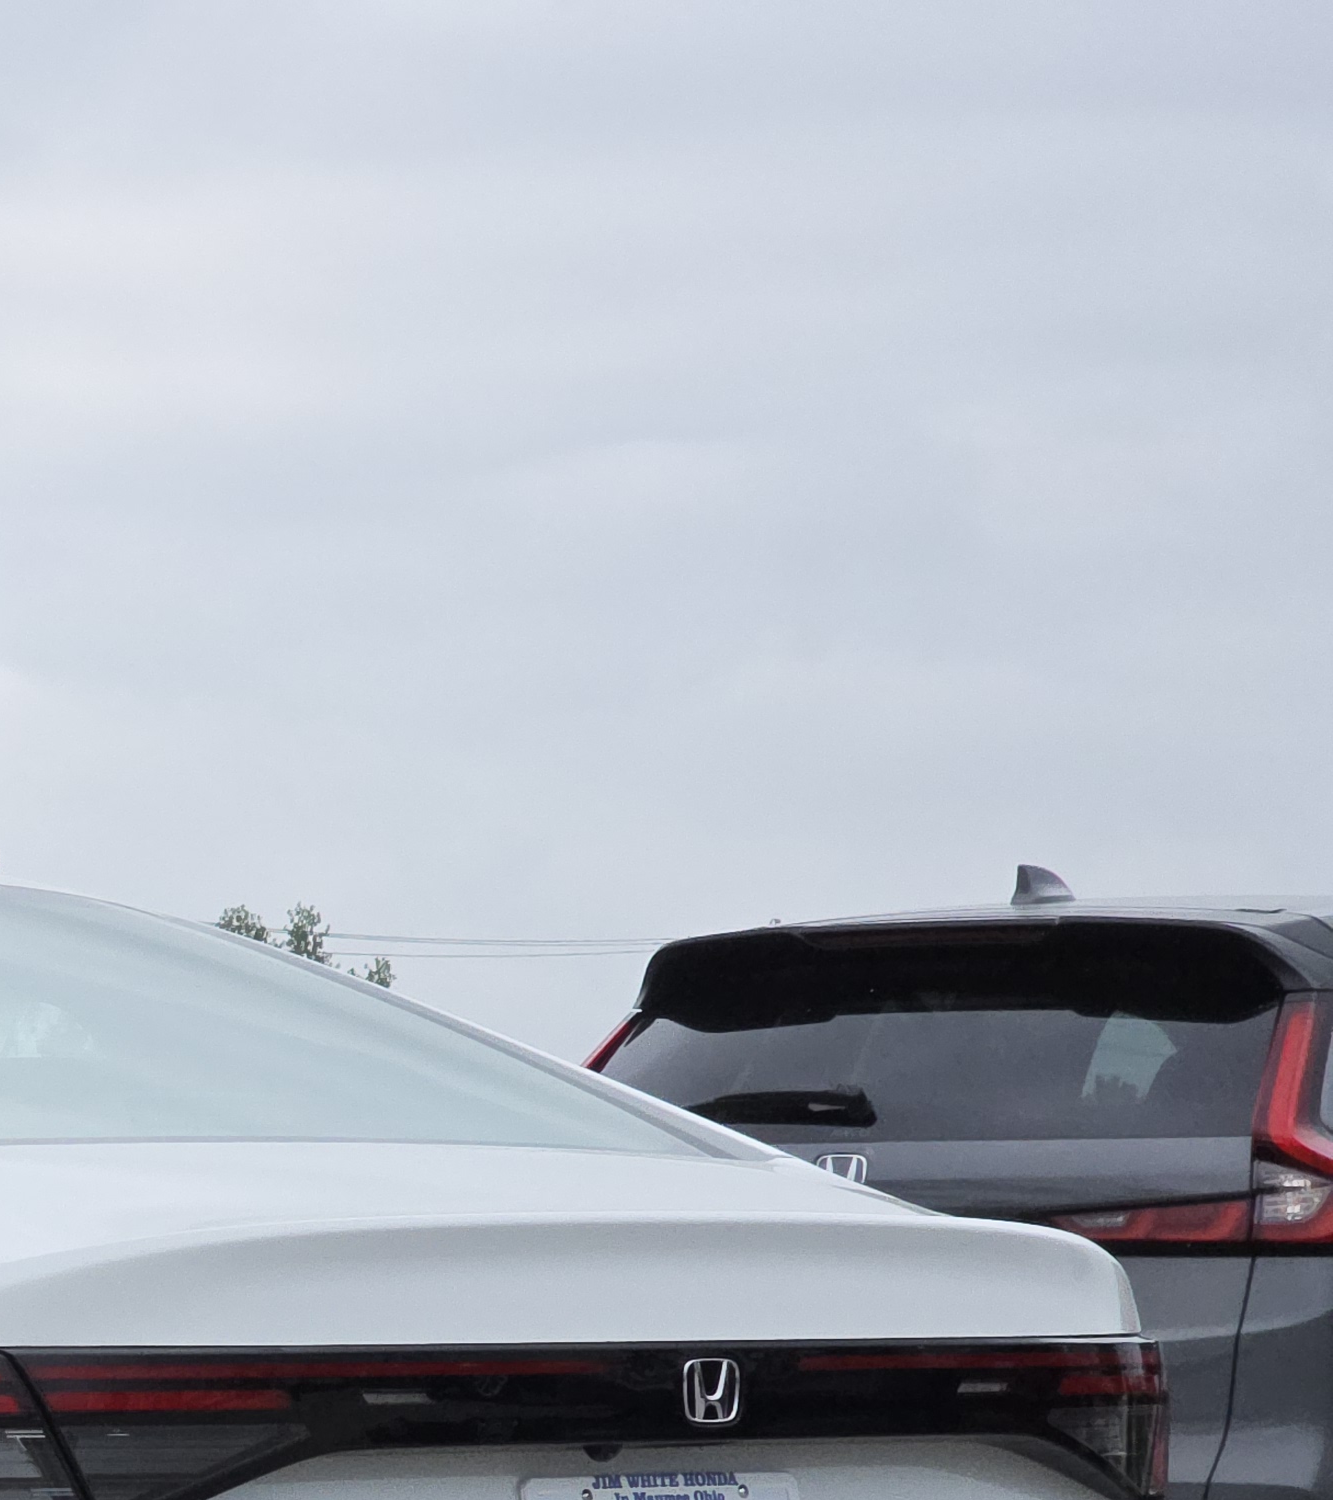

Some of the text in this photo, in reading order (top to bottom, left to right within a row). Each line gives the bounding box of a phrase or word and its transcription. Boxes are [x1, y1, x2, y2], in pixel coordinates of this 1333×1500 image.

[591, 1471, 739, 1490] JIM WHITE HONDA
